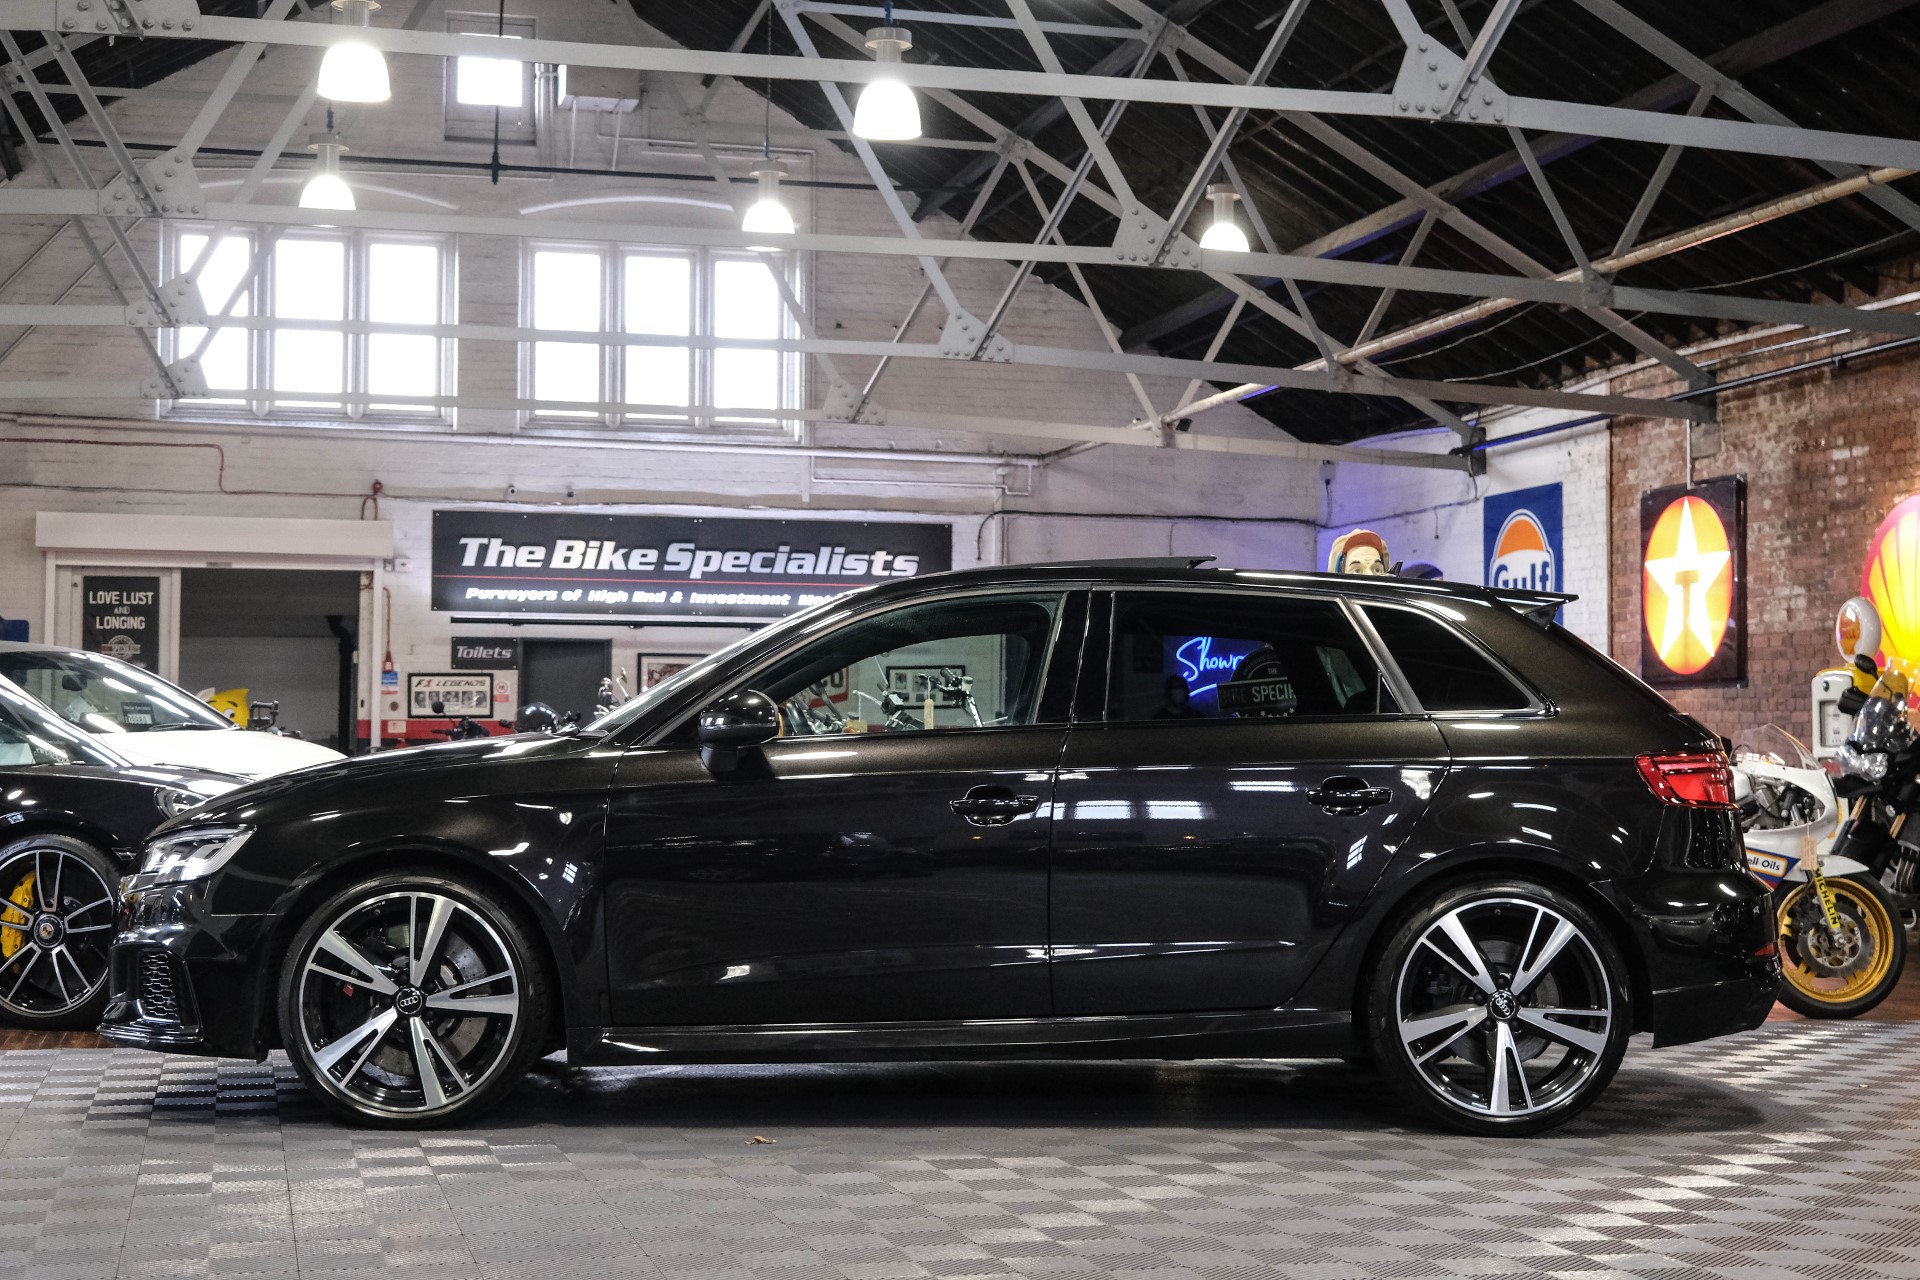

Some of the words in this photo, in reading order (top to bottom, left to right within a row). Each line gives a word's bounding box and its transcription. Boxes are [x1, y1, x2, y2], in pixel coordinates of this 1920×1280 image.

[459, 537, 546, 568] The
[549, 539, 659, 571] Bike
[663, 543, 919, 579] Specialists
[89, 591, 120, 604] LOVE
[123, 591, 154, 605] LUST
[465, 587, 558, 602] Purveyors
[561, 589, 582, 601] of
[588, 589, 629, 603] High
[632, 590, 666, 603] End
[670, 591, 683, 603] &
[690, 592, 791, 605] Investment
[113, 606, 130, 614] AND
[95, 616, 146, 629] LONGING
[456, 646, 513, 659] Toilets
[1176, 637, 1246, 681] Showr
[414, 679, 432, 688] F1
[1747, 856, 1759, 865] ell
[1762, 860, 1780, 871] Oils
[1815, 867, 1838, 925] MICHELIN
